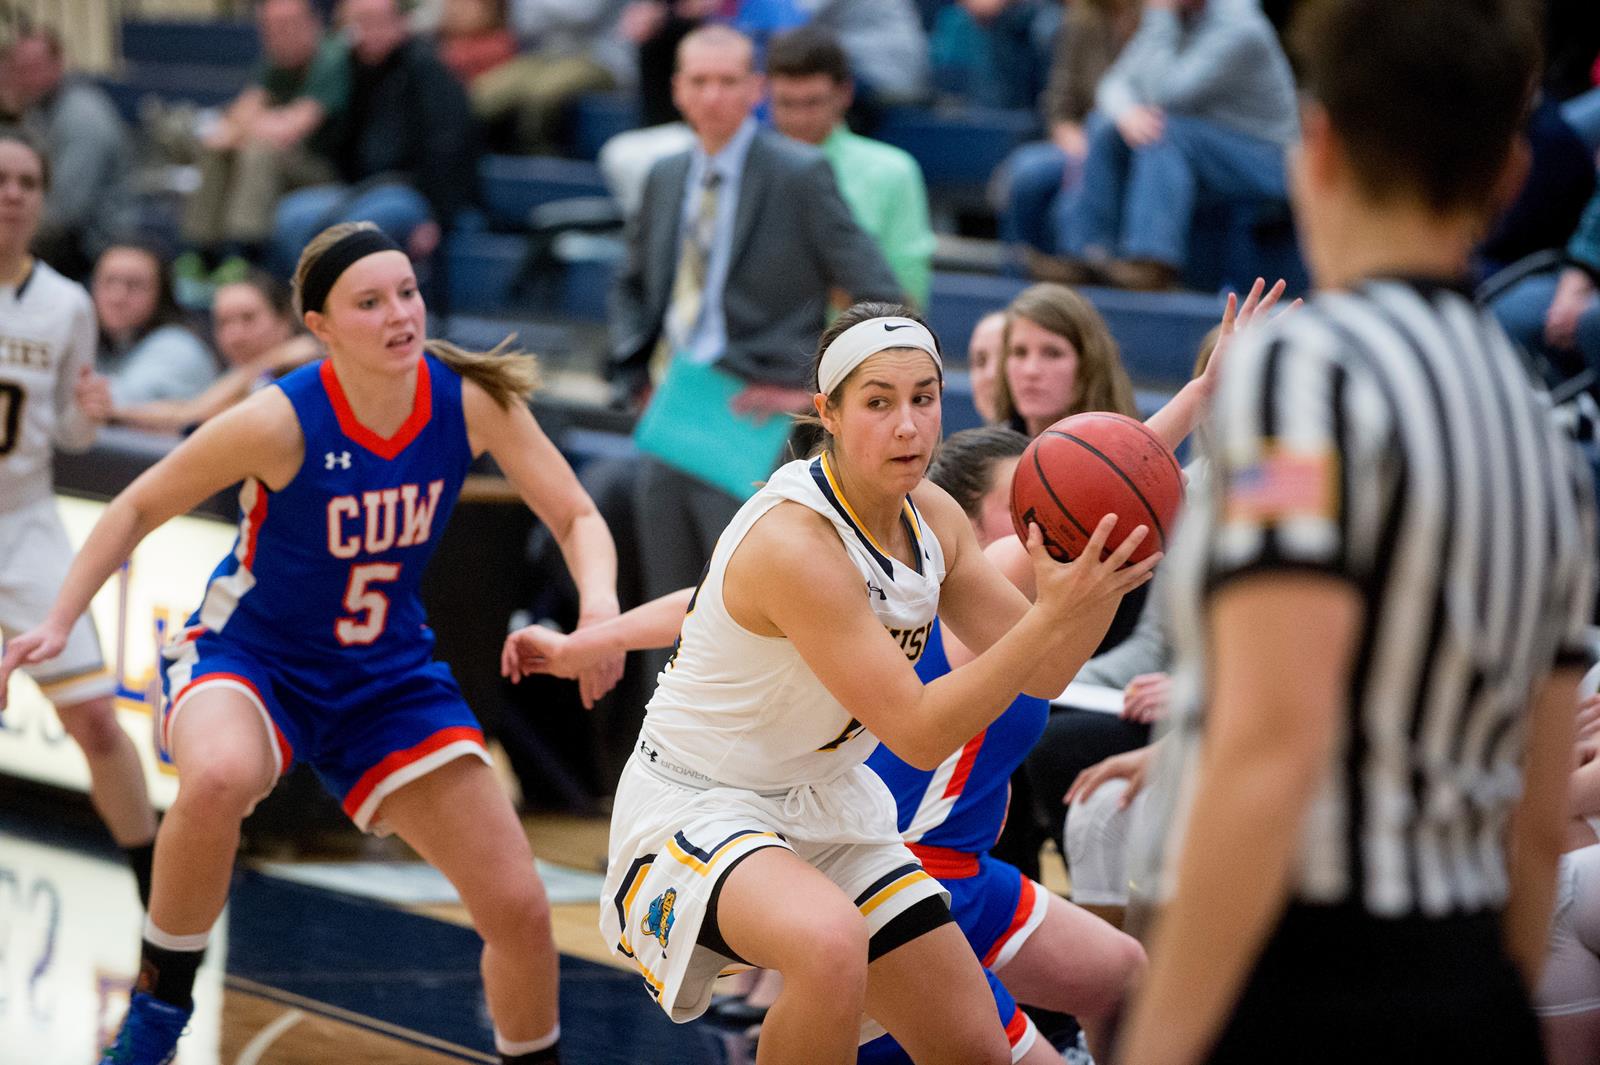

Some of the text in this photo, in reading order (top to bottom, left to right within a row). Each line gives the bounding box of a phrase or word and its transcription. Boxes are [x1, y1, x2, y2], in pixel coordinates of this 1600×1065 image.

[327, 479, 445, 559] CUW
[333, 563, 401, 647] 5
[660, 760, 712, 782] ARMOUR
